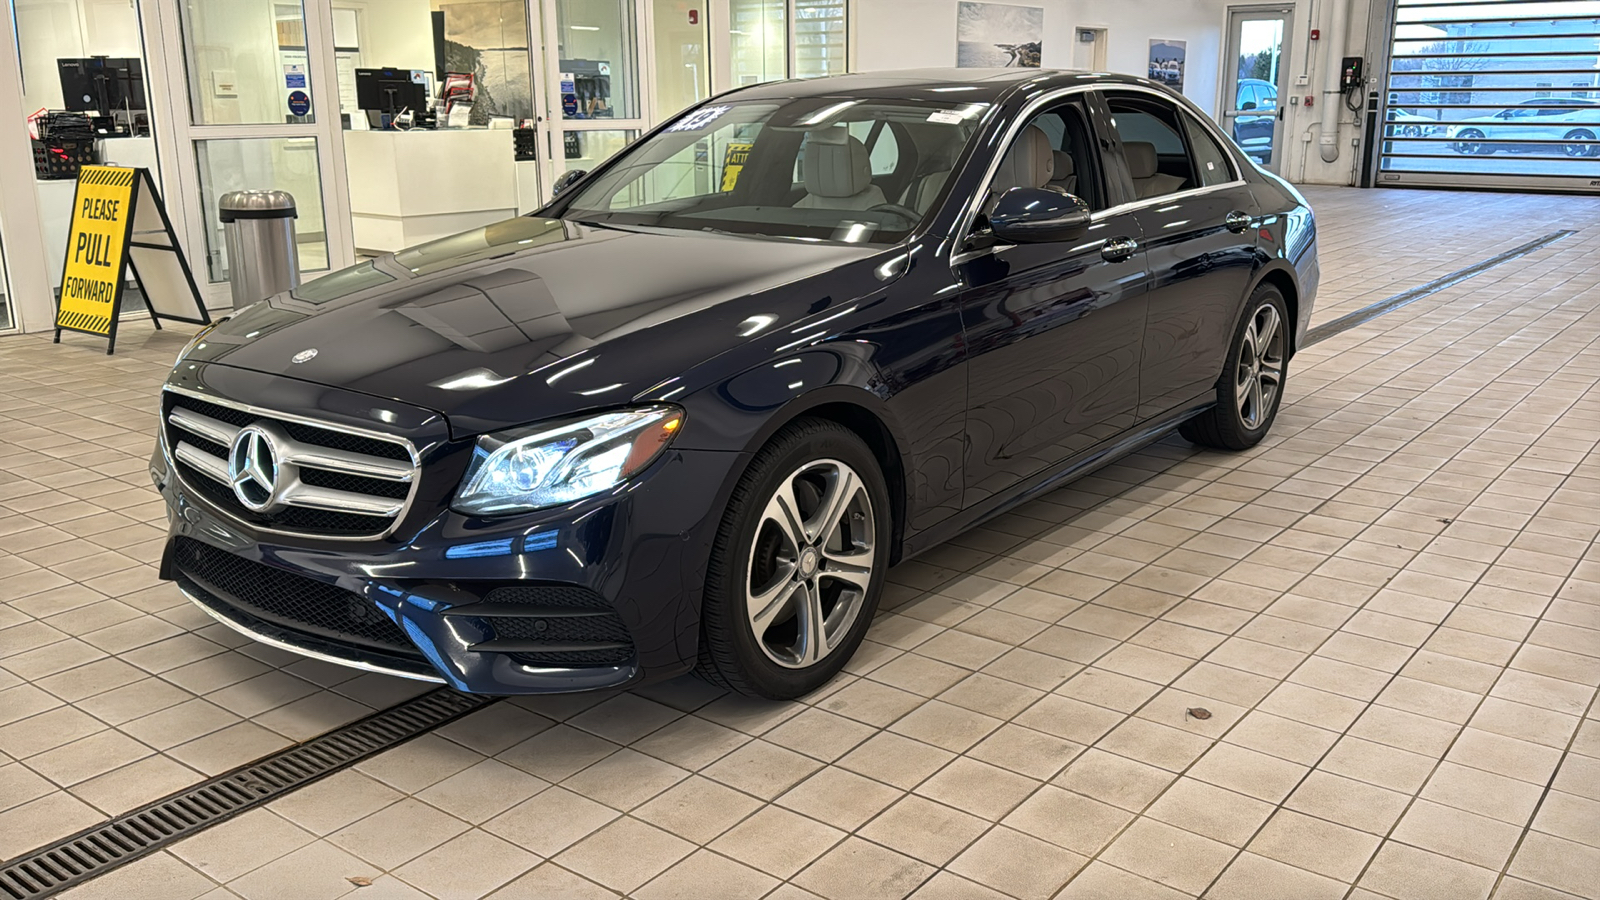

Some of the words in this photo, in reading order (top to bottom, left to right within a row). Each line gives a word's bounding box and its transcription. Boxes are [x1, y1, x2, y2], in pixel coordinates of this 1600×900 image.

[82, 197, 120, 222] PLEASE
[75, 231, 112, 268] PULL
[65, 276, 114, 304] FORWARD
